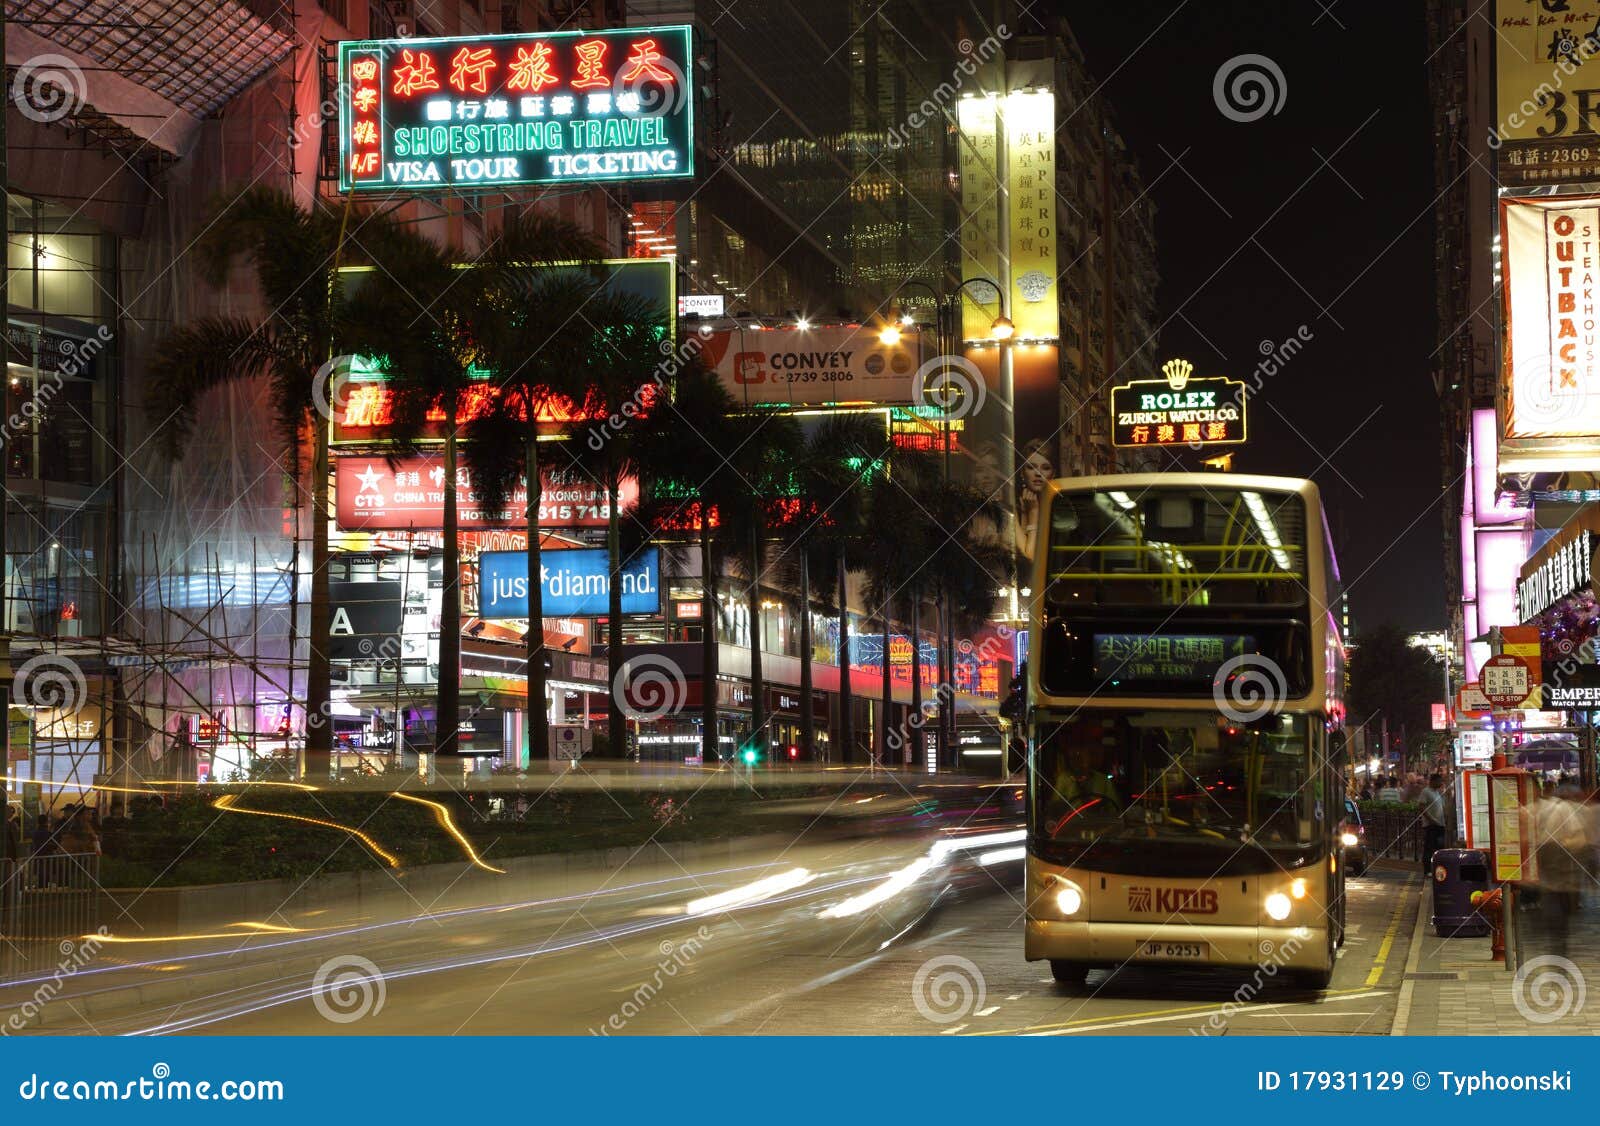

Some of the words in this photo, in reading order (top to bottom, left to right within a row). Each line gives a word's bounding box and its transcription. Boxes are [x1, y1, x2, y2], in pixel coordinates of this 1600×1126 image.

[395, 121, 562, 157] SHOESTRING
[570, 117, 669, 148] TRAVEL
[387, 160, 441, 184] VISA
[451, 157, 520, 181] TOUR
[549, 150, 677, 177] TICKETING
[1037, 131, 1052, 258] EMPEROR
[1553, 215, 1578, 389] OUTBACK
[1581, 225, 1595, 377] STEAKHOUSE
[770, 351, 854, 370] CONVEY
[822, 371, 854, 382] 3806
[1141, 391, 1216, 410] ROLEX
[1118, 411, 1167, 425] ZURICH
[1169, 409, 1215, 423] WATCH
[354, 494, 385, 508] CTS
[393, 491, 426, 503] CHINA
[427, 491, 467, 503] TRAEL
[1156, 886, 1219, 914] KMB
[1144, 943, 1162, 956] JP
[1166, 943, 1201, 957] 6253
